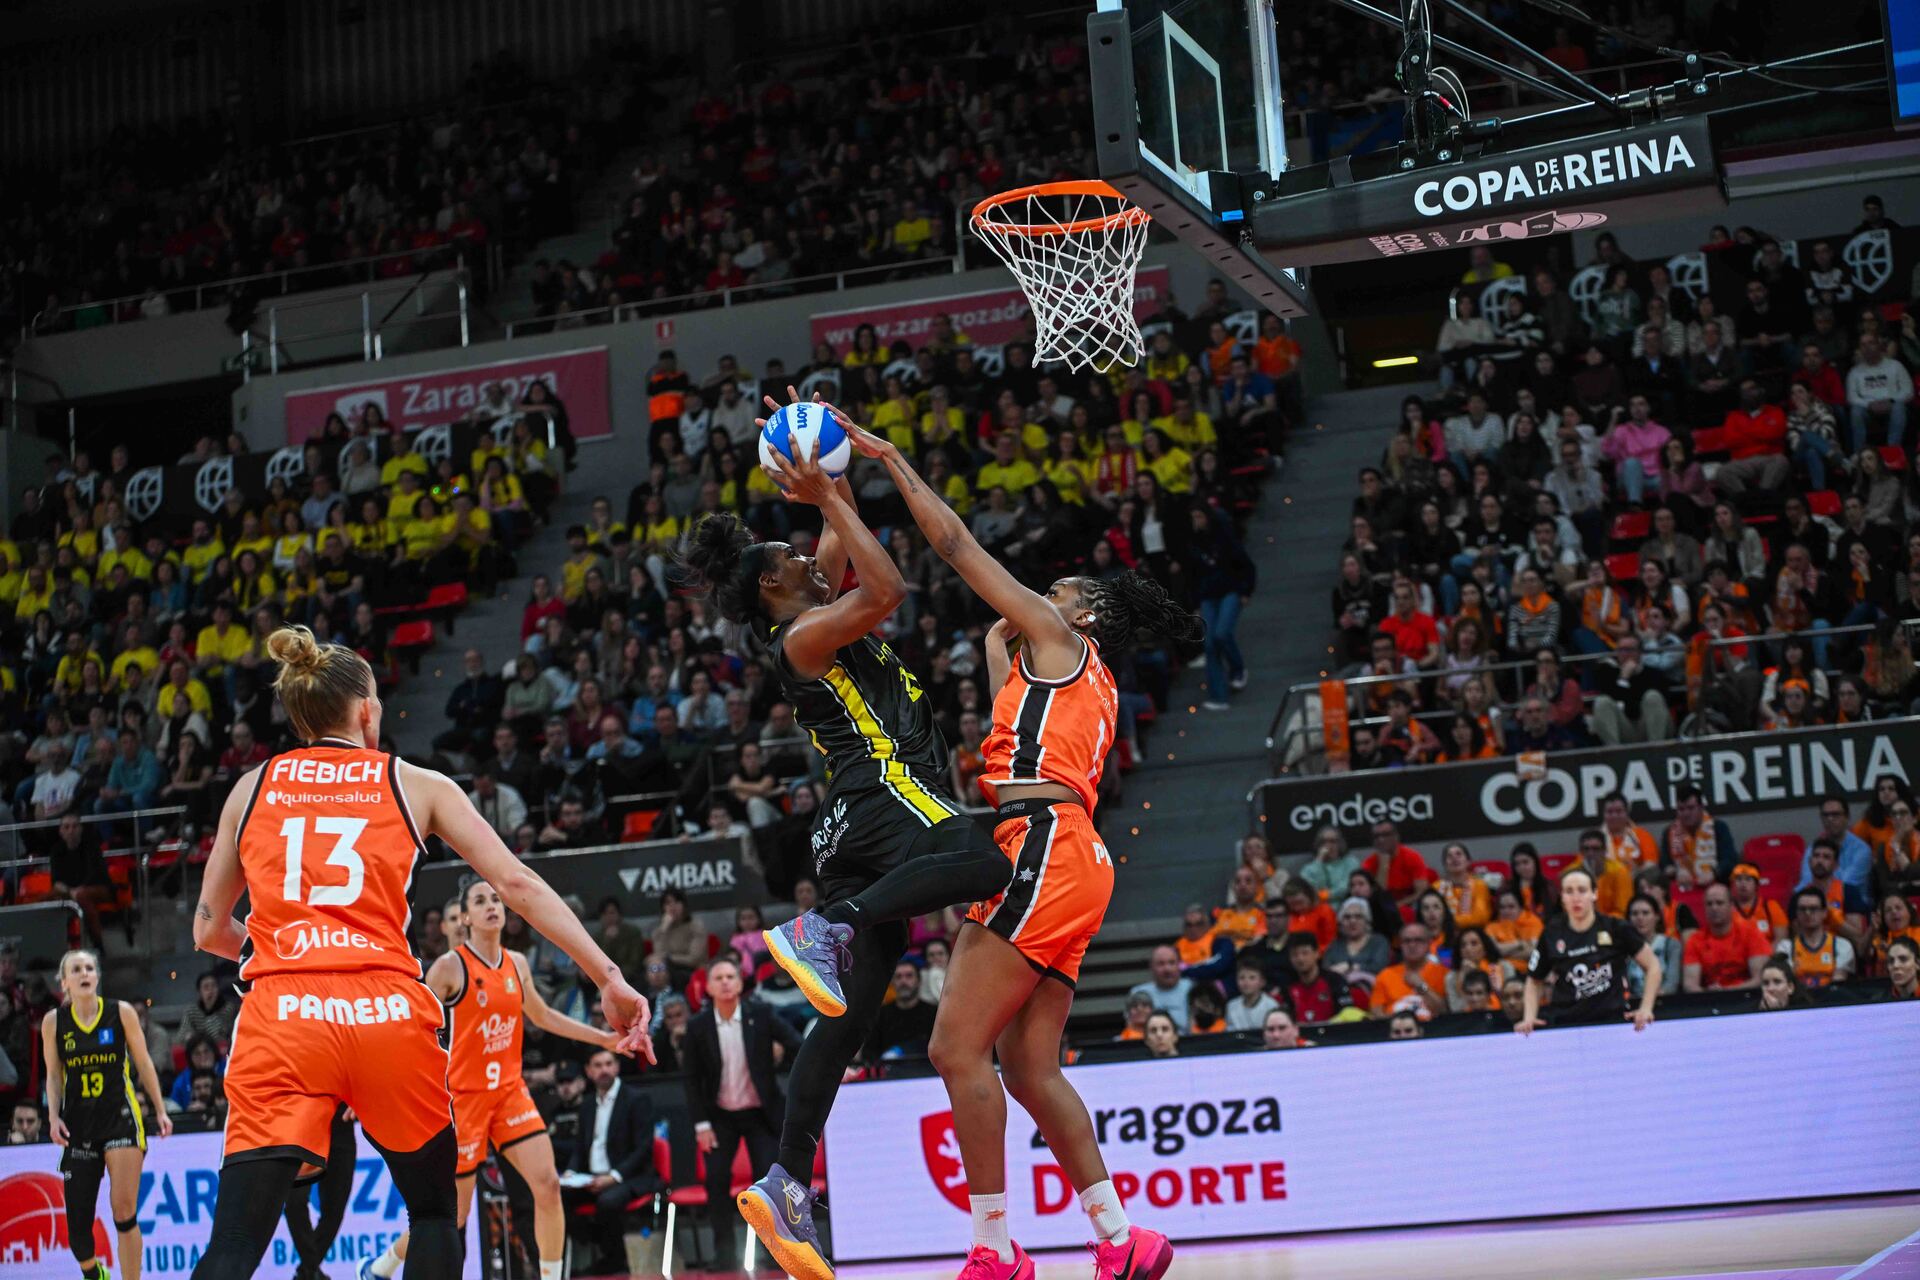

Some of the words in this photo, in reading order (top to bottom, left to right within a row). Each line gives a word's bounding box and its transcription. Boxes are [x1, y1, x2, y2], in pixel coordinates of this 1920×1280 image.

[1414, 165, 1535, 217] COPA
[1535, 158, 1558, 178] DE
[1563, 134, 1696, 190] REINA
[1538, 176, 1564, 196] LA
[271, 758, 384, 784] FIEBICH
[1290, 792, 1433, 832] endesa
[1480, 760, 1664, 826] COPA
[1666, 754, 1704, 782] DE
[1710, 734, 1909, 806] REINA
[281, 790, 381, 808] quironsalud
[279, 816, 366, 906] 13
[640, 859, 737, 892] AMBAR
[278, 993, 412, 1026] PAMESA
[81, 1072, 104, 1098] 13
[485, 1061, 501, 1091] 9
[1030, 1096, 1282, 1157] ragoza
[1032, 1161, 1288, 1216] DPORTE
